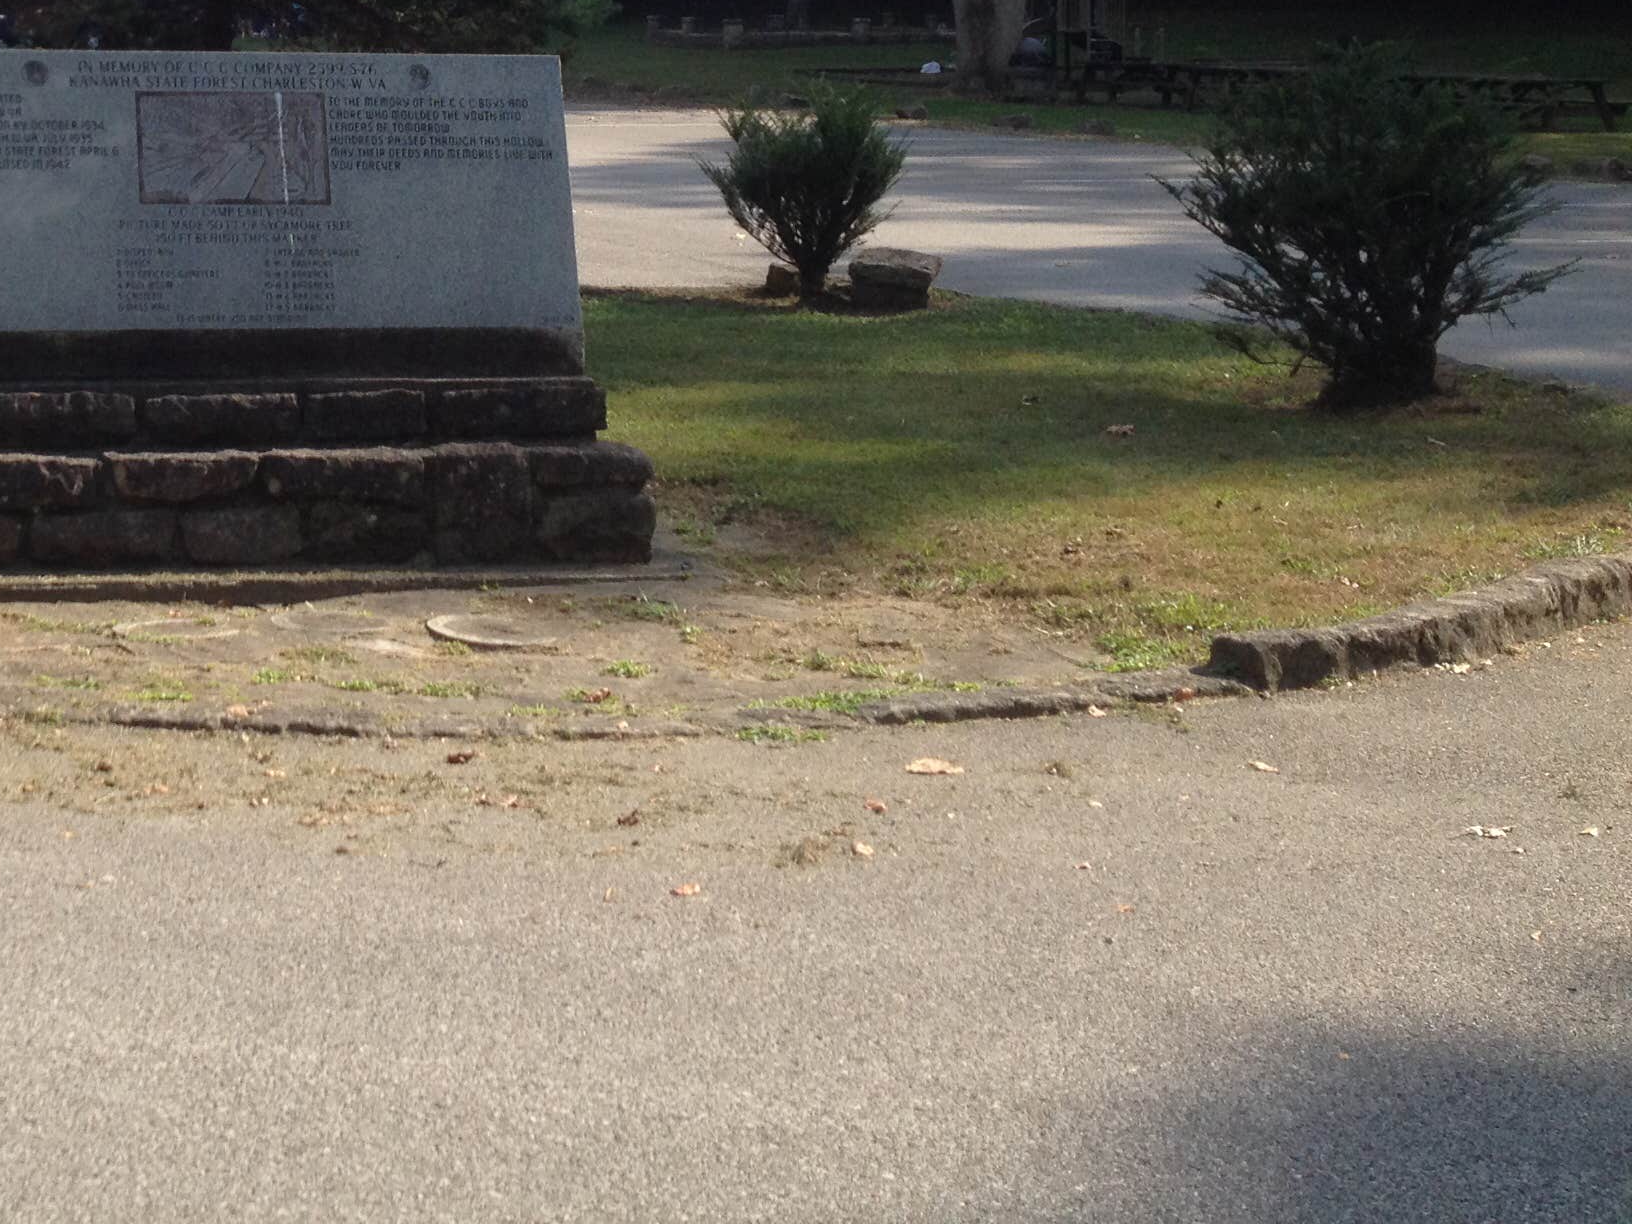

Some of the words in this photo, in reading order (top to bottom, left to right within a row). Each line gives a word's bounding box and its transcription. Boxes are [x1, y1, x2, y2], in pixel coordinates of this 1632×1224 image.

[78, 60, 93, 75] IN
[99, 60, 158, 75] MEMORY
[165, 60, 184, 75] OF
[233, 60, 301, 75] COMPANY
[68, 76, 141, 88] KANAWHA
[146, 76, 184, 88] STATE
[193, 76, 247, 88] FOREST
[252, 76, 347, 88] CHARLESTON
[328, 95, 340, 108] TO
[343, 95, 360, 108] THE
[364, 95, 410, 108] MEMORY
[413, 95, 425, 108] OF
[428, 95, 444, 108] THE
[478, 95, 505, 108] BOYS
[507, 95, 529, 108] AND
[365, 109, 388, 121] WHO
[391, 109, 440, 121] MOULDED
[441, 109, 459, 121] THE
[463, 109, 497, 121] YOUTH
[499, 109, 522, 121] INTO
[31, 119, 78, 130] OCTOBER
[328, 122, 374, 133] LEADERS
[376, 122, 388, 133] OF
[391, 122, 450, 133] TOMORROW
[329, 135, 384, 147] HUNDREDS
[387, 135, 426, 147] PASSED
[429, 135, 476, 147] THROUGH
[479, 135, 501, 147] THIS
[5, 145, 35, 156] STATE
[38, 145, 76, 156] FOREST
[79, 145, 109, 156] APRIL
[330, 147, 354, 160] MAY
[358, 147, 385, 160] THEIR
[388, 147, 421, 160] DEEDS
[423, 147, 445, 160] AND
[447, 147, 501, 160] MEMORIES
[504, 147, 527, 160] LIVE
[528, 147, 553, 160] WITH
[330, 160, 353, 171] YOU
[356, 160, 401, 171] FOREVER
[237, 206, 271, 218] EARLY
[261, 219, 321, 231] SYCAMORE
[325, 219, 352, 231] TREE
[195, 232, 239, 244] BEHIND
[242, 232, 270, 244] THIS
